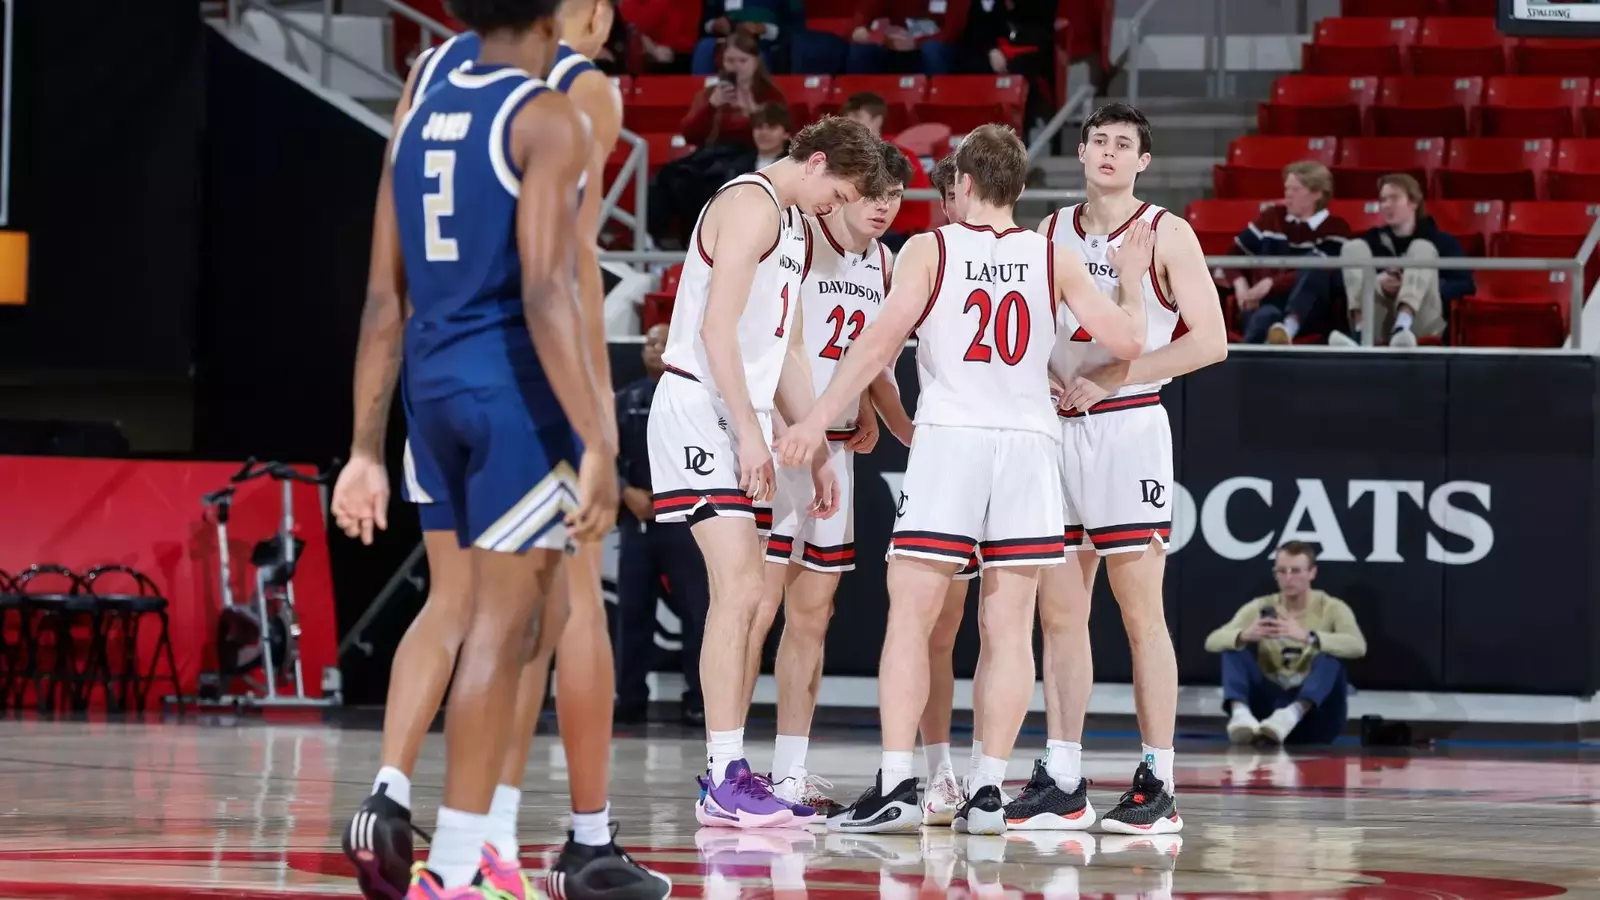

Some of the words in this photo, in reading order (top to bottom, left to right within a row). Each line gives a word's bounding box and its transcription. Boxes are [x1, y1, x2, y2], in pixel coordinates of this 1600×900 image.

[1527, 8, 1571, 18] SPALDING
[423, 149, 460, 262] 2
[818, 280, 882, 304] DAVIDSON
[774, 281, 789, 338] 1
[962, 287, 1031, 366] 20
[683, 445, 716, 476] DC
[1138, 478, 1166, 509] DC
